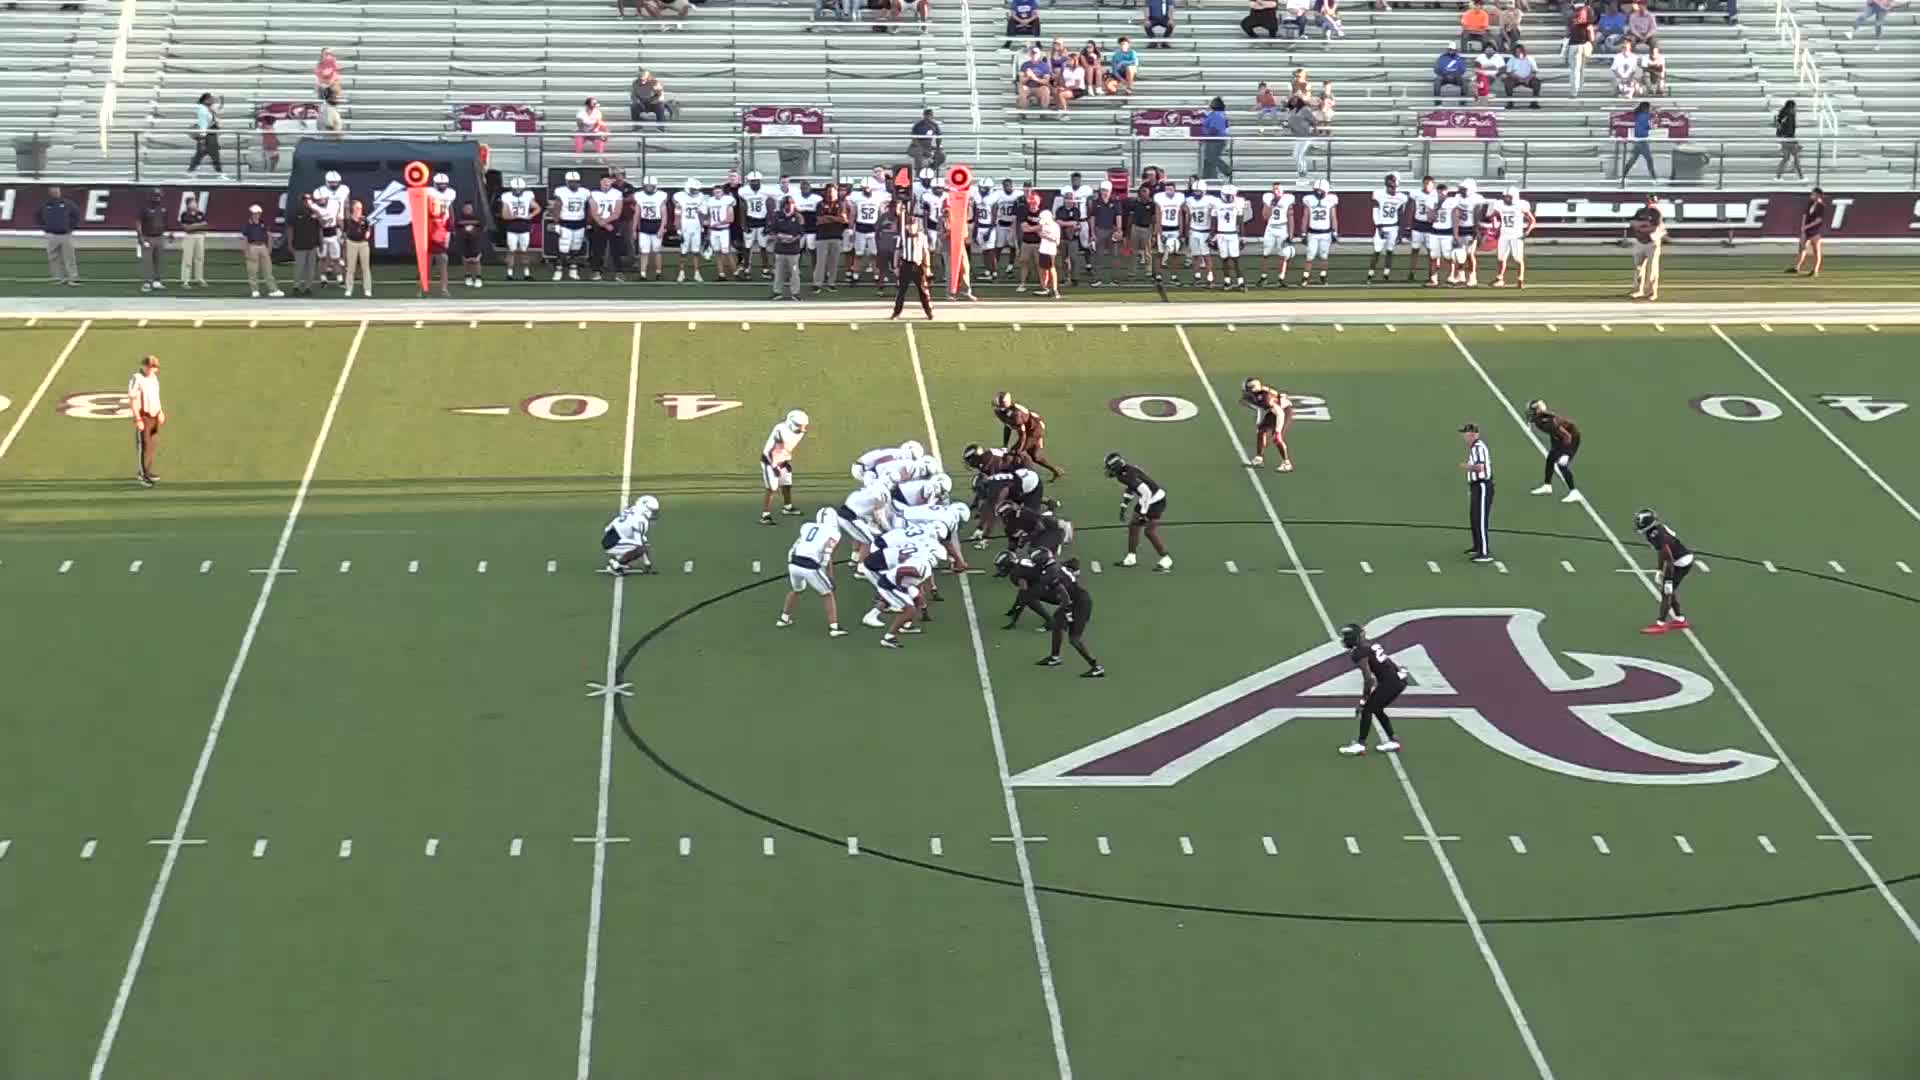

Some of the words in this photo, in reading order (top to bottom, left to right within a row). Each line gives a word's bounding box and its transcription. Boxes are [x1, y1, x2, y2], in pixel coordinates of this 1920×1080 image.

[895, 167, 911, 188] 4
[861, 208, 876, 219] 52
[1273, 209, 1281, 221] 9
[1312, 210, 1327, 221] 32
[1383, 206, 1397, 218] 58
[1503, 216, 1515, 228] 15
[806, 526, 820, 542] 0
